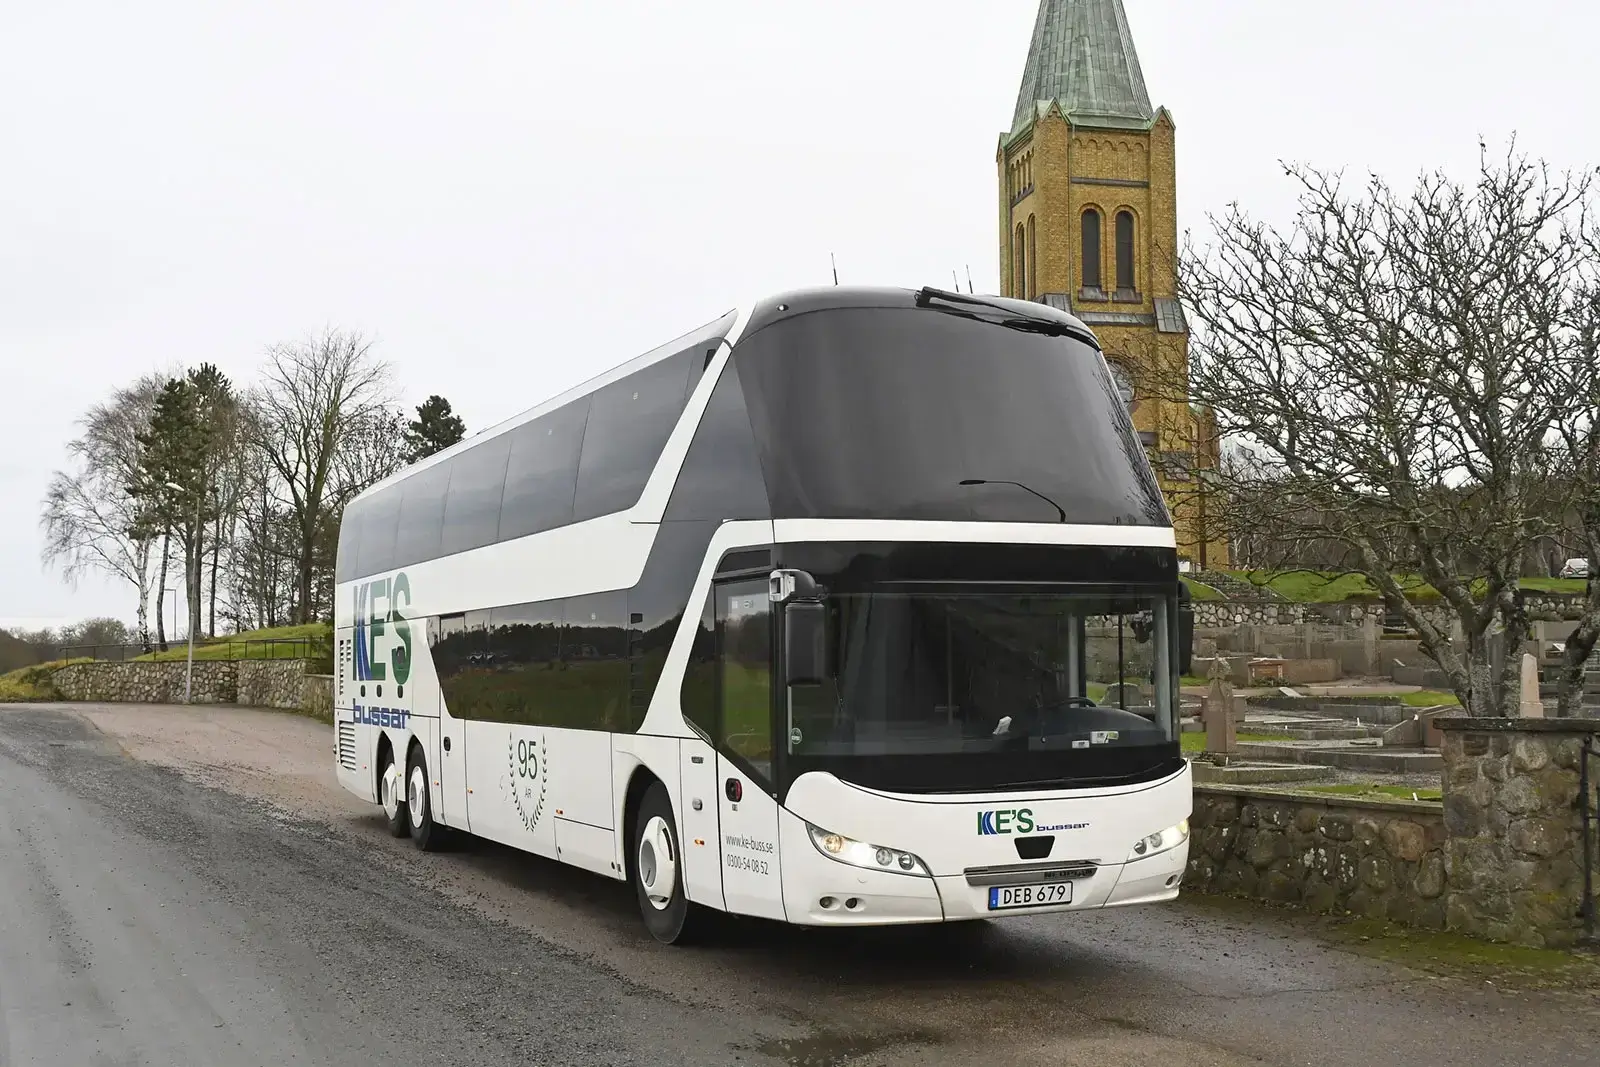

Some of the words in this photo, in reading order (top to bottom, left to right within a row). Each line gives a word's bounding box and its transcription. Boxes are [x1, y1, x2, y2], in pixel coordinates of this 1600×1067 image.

[353, 572, 411, 685] KE'S
[353, 698, 410, 729] bussar
[518, 739, 537, 779] 95
[977, 808, 1034, 835] KE'S
[1036, 823, 1090, 832] bussar
[726, 833, 773, 853] www.ke-buss.se
[727, 854, 750, 870] 0300-54
[751, 859, 759, 872] 08
[760, 861, 768, 875] 52
[1003, 887, 1032, 904] DEB
[1036, 885, 1066, 902] 679
